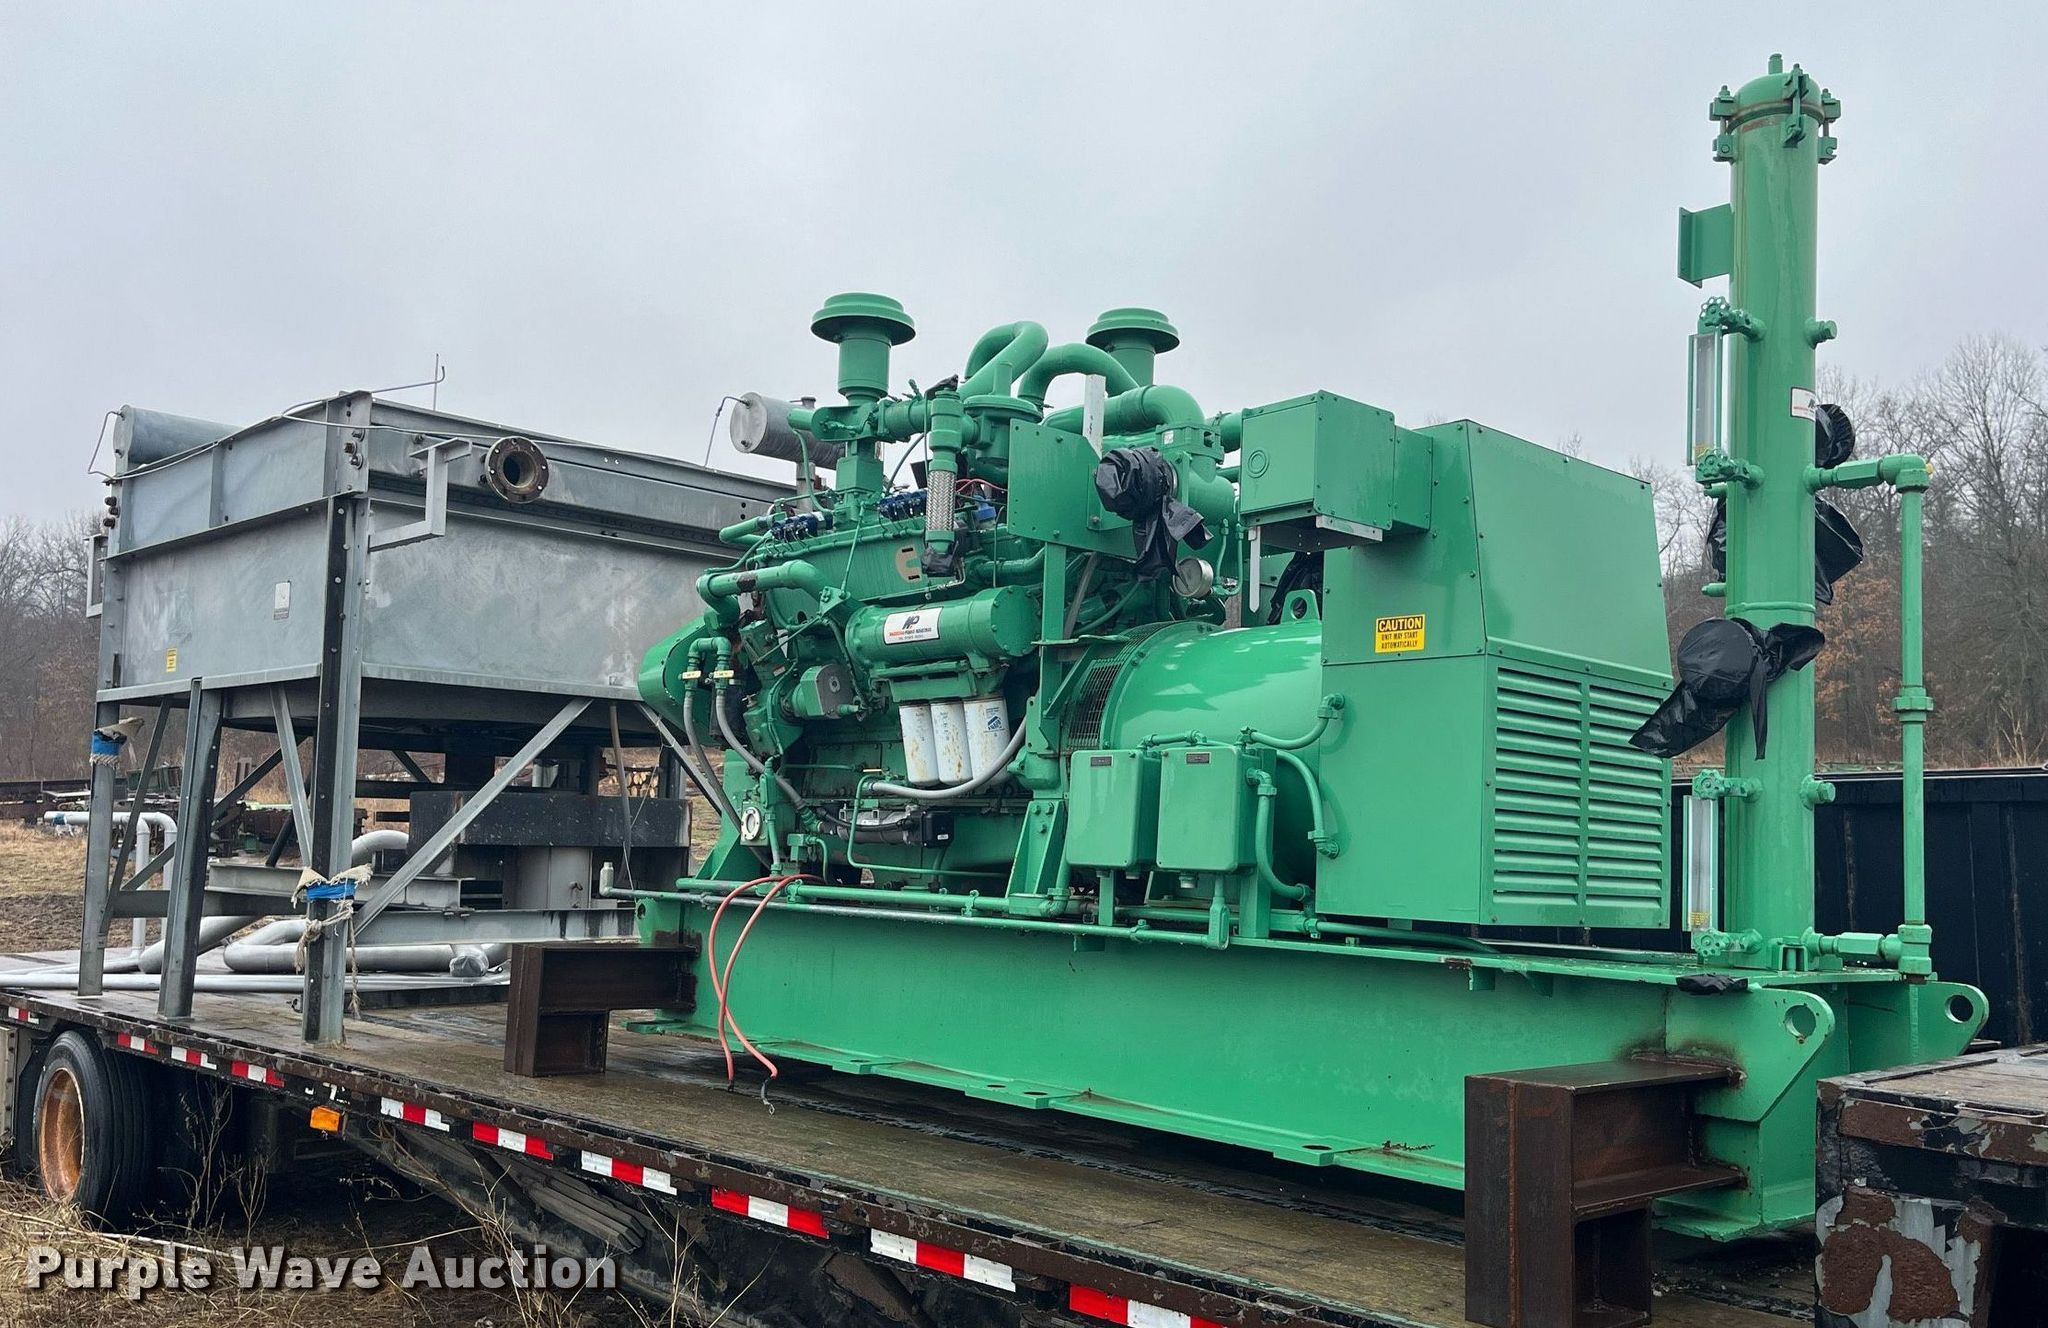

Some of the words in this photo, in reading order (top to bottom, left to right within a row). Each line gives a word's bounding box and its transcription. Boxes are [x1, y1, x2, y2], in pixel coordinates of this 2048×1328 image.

[1378, 617, 1422, 632] CAUTION
[1381, 633, 1392, 641] UNIT
[1393, 632, 1404, 640] MAY
[1404, 631, 1418, 639] START
[1381, 640, 1418, 649] AUTOMATICALLY
